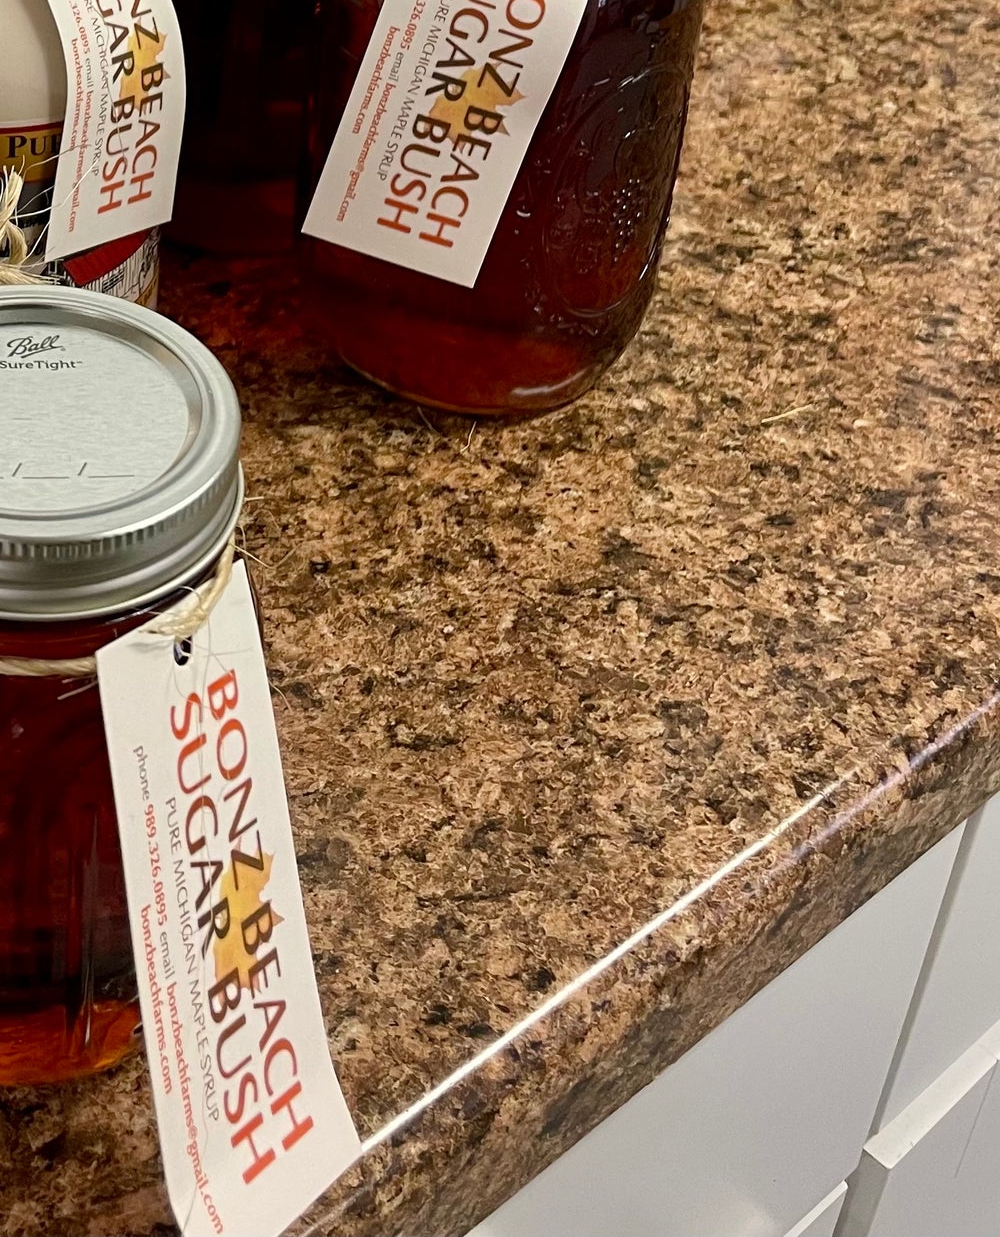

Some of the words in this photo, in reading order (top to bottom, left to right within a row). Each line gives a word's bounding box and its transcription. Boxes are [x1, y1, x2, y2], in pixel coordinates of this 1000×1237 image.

[69, 37, 86, 152] bonzbeachfarms.com
[85, 56, 95, 90] email
[91, 16, 110, 91] MICHIGAN
[351, 25, 401, 135] bonzbeachfarms.com
[392, 50, 405, 83] email
[408, 24, 442, 97] MICHIGAN
[94, 92, 109, 137] MAPLE
[96, 94, 136, 215] BUSH
[127, 61, 165, 206] BEACH
[336, 82, 397, 223] bonzbeachfarms@gmail.com
[390, 96, 415, 141] MAPLE
[376, 141, 399, 182] SYRUP
[376, 113, 452, 235] BUSH
[418, 104, 505, 249] BEACH
[6, 334, 64, 358] Ball
[132, 744, 151, 802] phone
[143, 803, 168, 927] 989.326.0895
[165, 795, 183, 855] PURE
[159, 929, 175, 981] email
[169, 691, 231, 961] SUGAR
[207, 966, 277, 1186] BUSH
[172, 858, 198, 976] MICHIGAN
[206, 667, 265, 892] BONZ
[240, 898, 315, 1152] BEACH
[140, 904, 173, 1096] bonzbeachfarms.com
[188, 977, 209, 1054] MAPLE
[165, 981, 224, 1235] bonzbeachfarms@gmail.com
[200, 1054, 220, 1122] SYRUP
